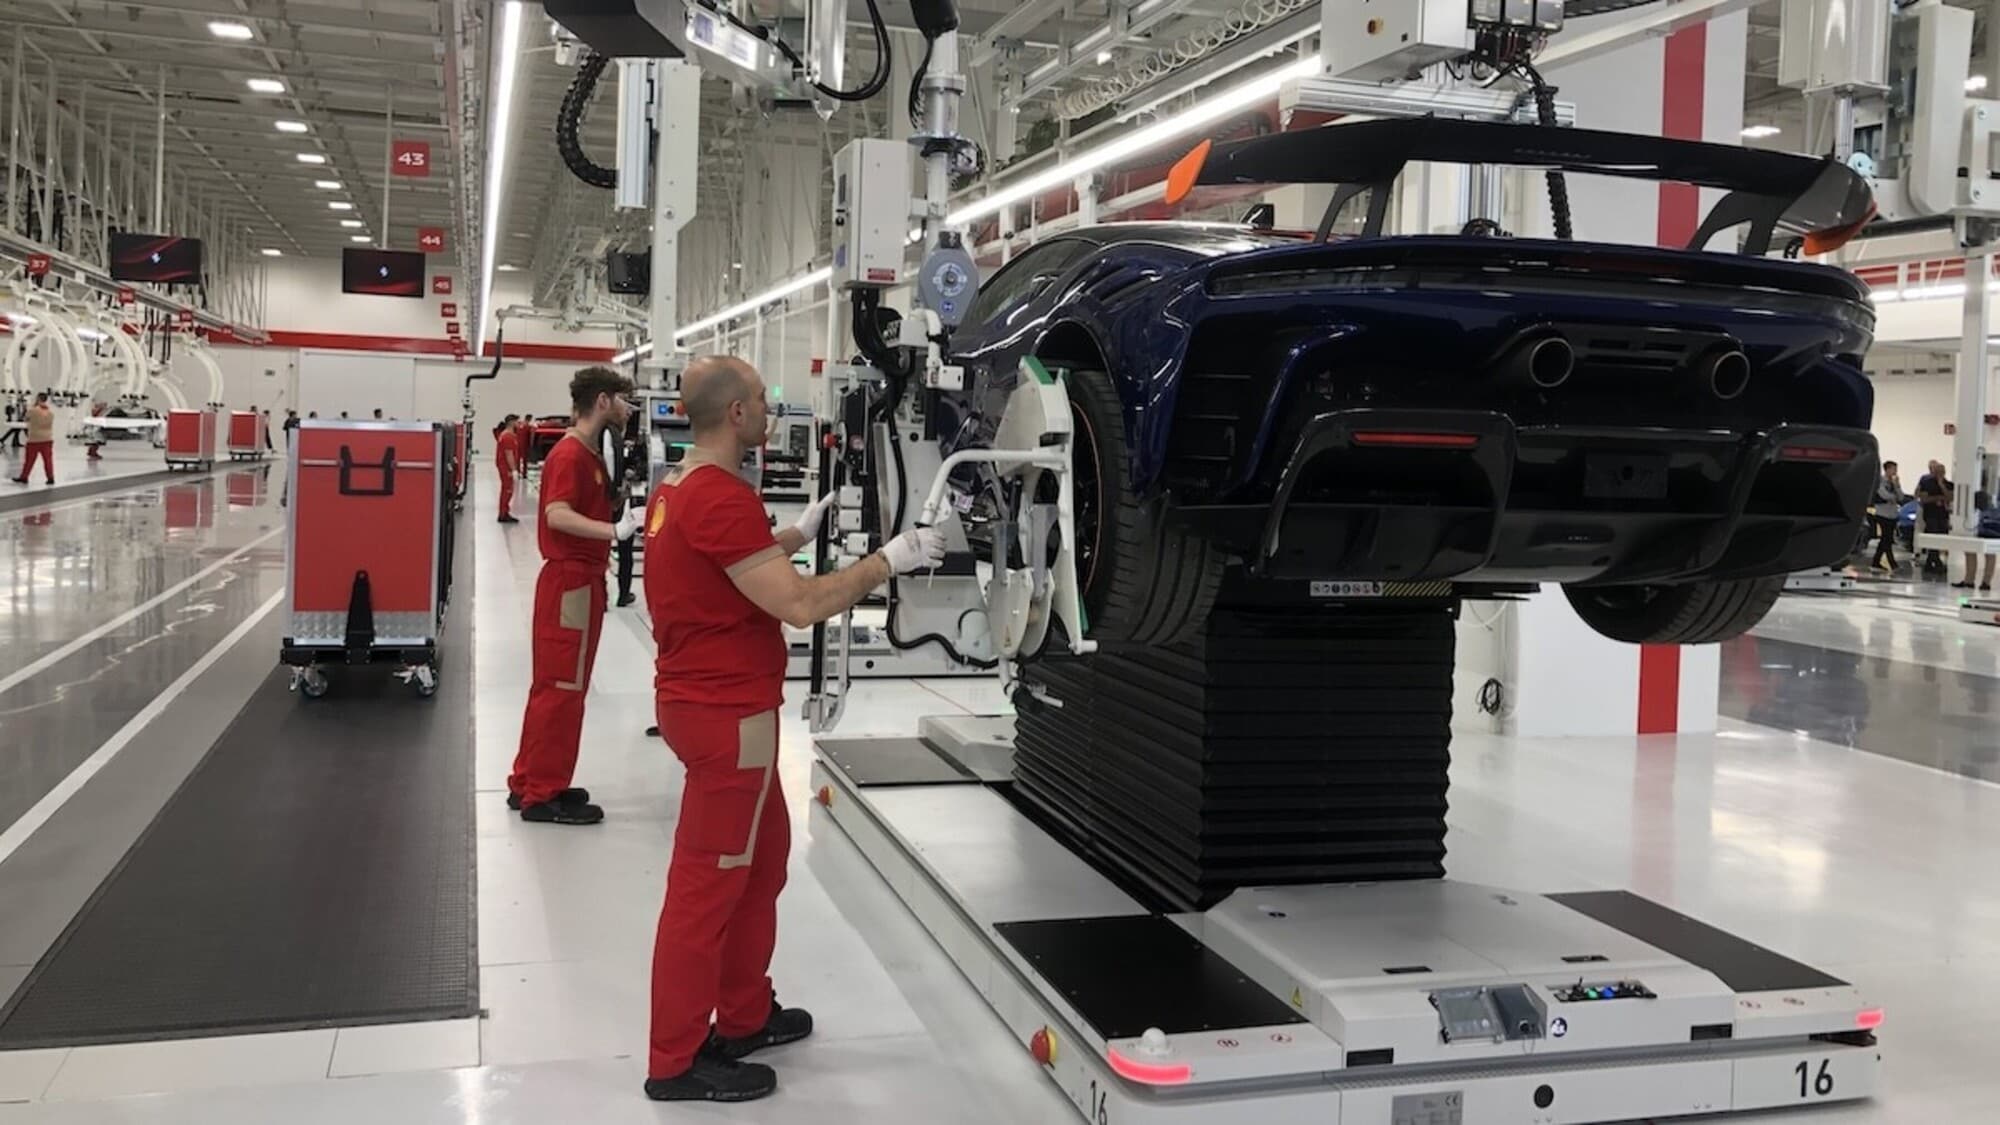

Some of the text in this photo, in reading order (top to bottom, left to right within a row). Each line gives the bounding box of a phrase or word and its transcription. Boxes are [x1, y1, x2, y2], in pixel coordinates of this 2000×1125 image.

[398, 152, 425, 166] 43
[421, 235, 441, 246] 44
[1795, 1058, 1834, 1097] 16
[1090, 1079, 1108, 1125] 16
